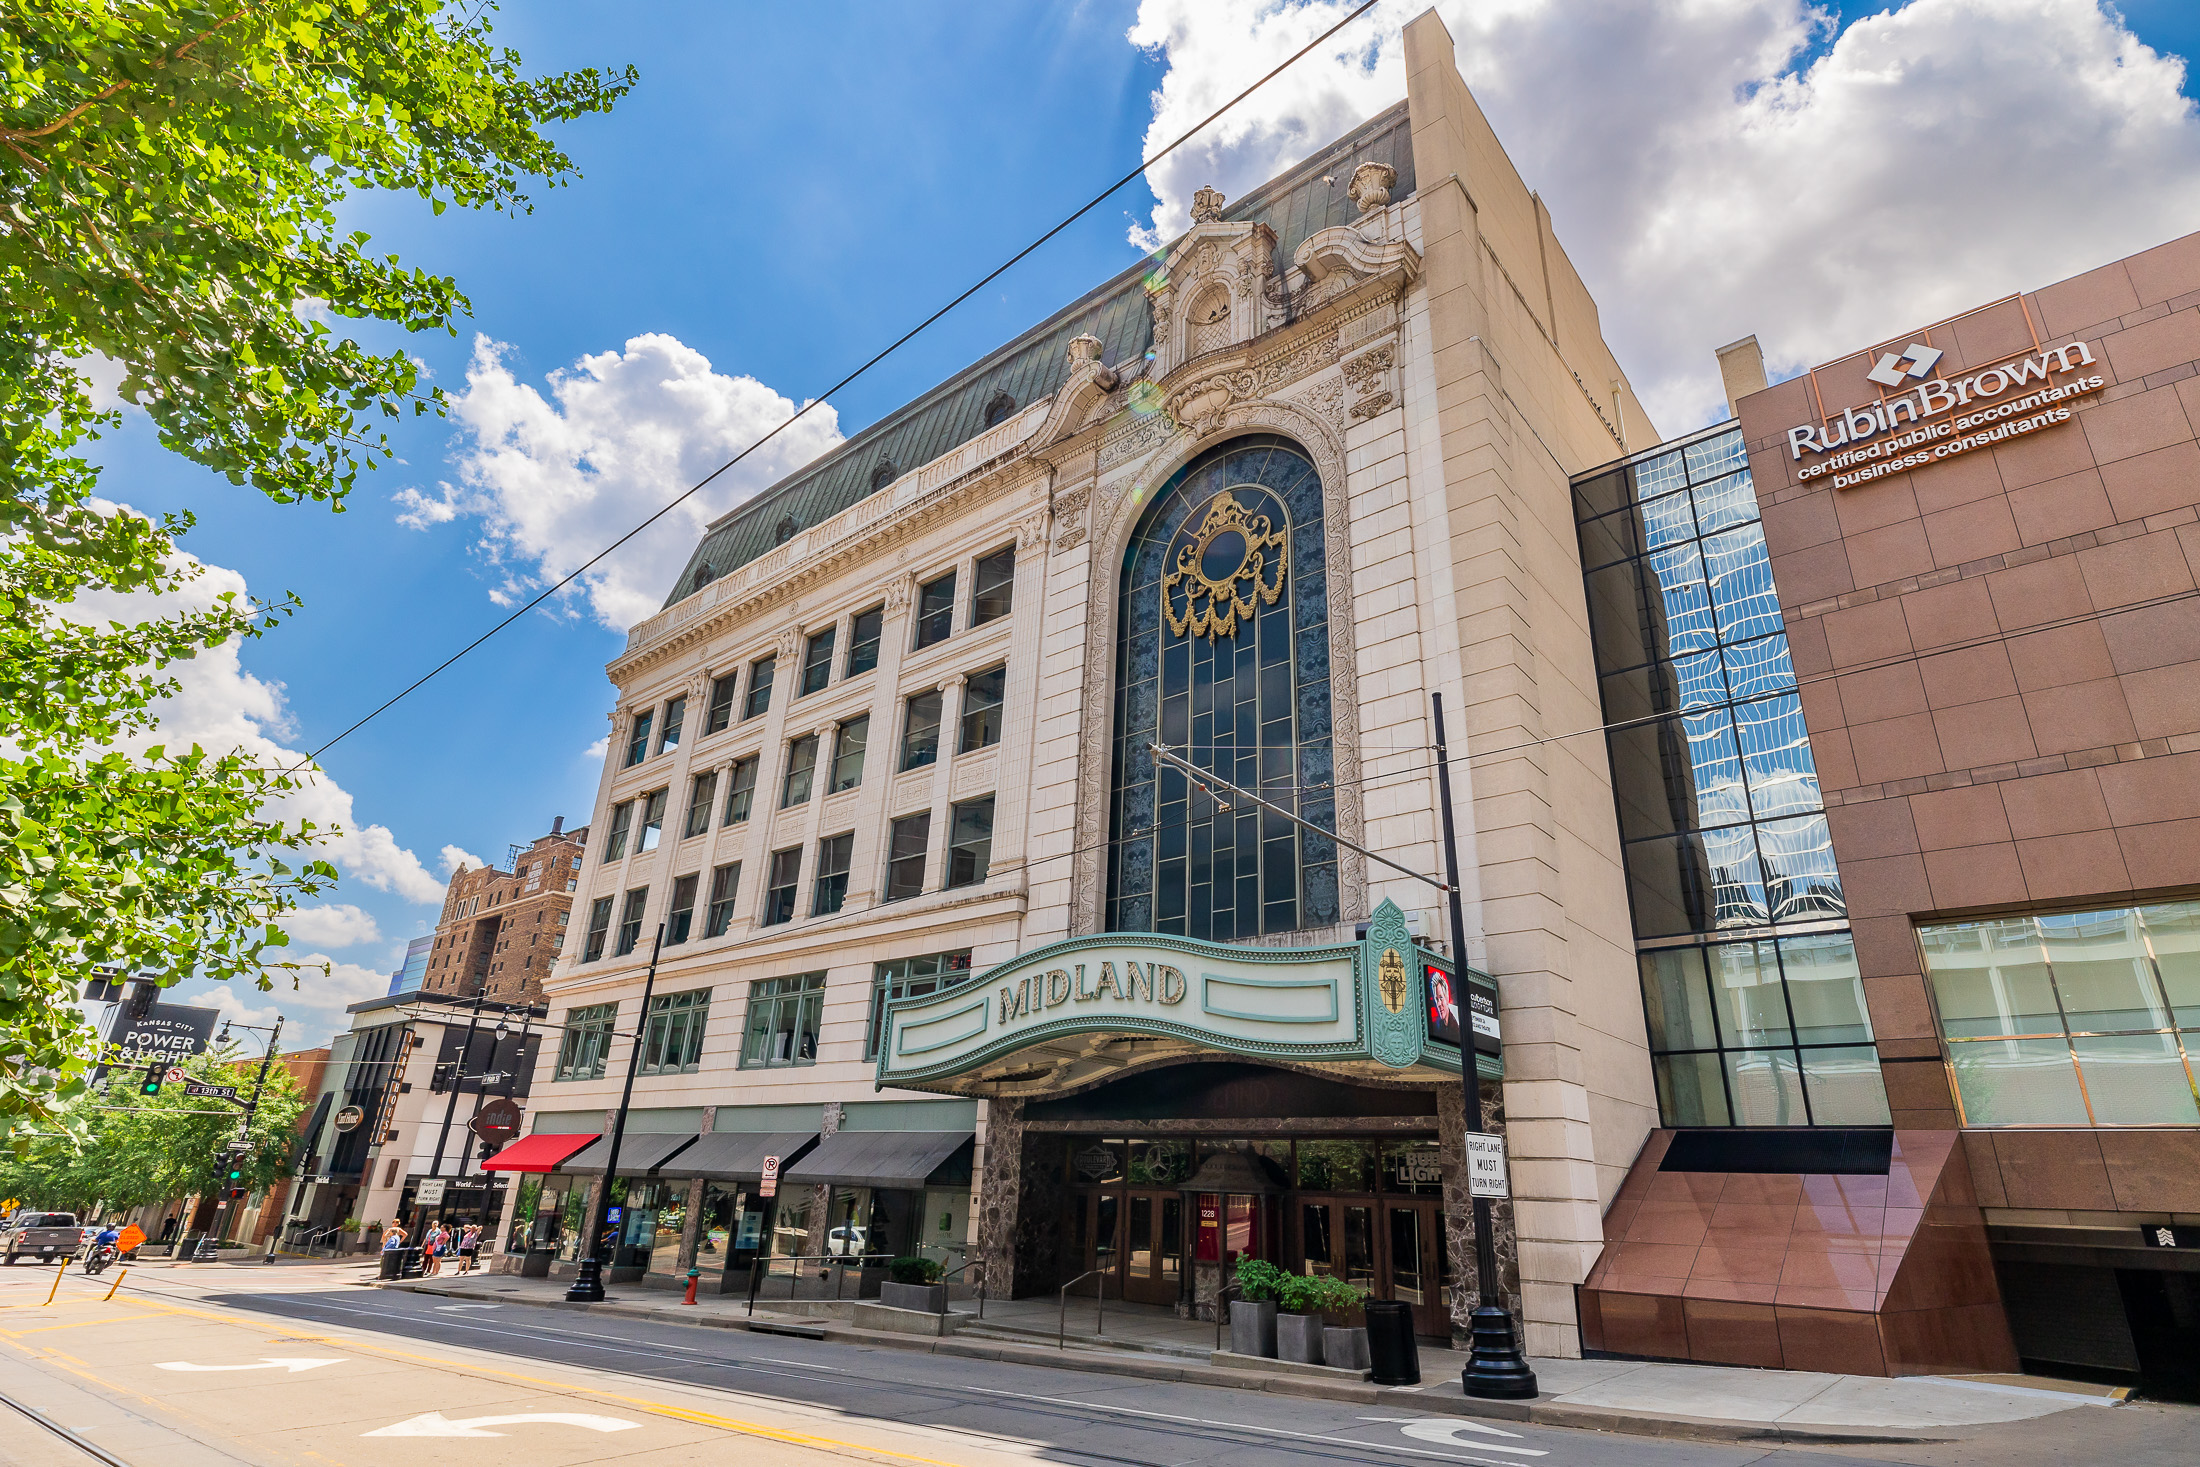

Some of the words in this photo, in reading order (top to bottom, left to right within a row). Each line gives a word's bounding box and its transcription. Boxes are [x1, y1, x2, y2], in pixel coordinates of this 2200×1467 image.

[1788, 341, 2097, 461] RubinBrown
[1797, 443, 1881, 480] certified
[1884, 424, 1950, 456] public
[1956, 375, 2104, 430] accountants
[1833, 451, 1930, 488] business
[1934, 407, 2071, 458] consultants
[999, 961, 1187, 1024] MIDLAND
[175, 1022, 194, 1032] CITY
[124, 1031, 195, 1050] POWER
[120, 1046, 133, 1059] &
[201, 1087, 218, 1095] 13th
[486, 1110, 512, 1125] indie
[1469, 1141, 1486, 1152] RIGHT
[1487, 1142, 1502, 1153] LANE
[1477, 1159, 1497, 1171] MUST
[1400, 1166, 1442, 1181] LIGH
[1472, 1178, 1488, 1188] TURN
[1489, 1179, 1505, 1189] RIGHT
[1201, 1209, 1215, 1218] 1228
